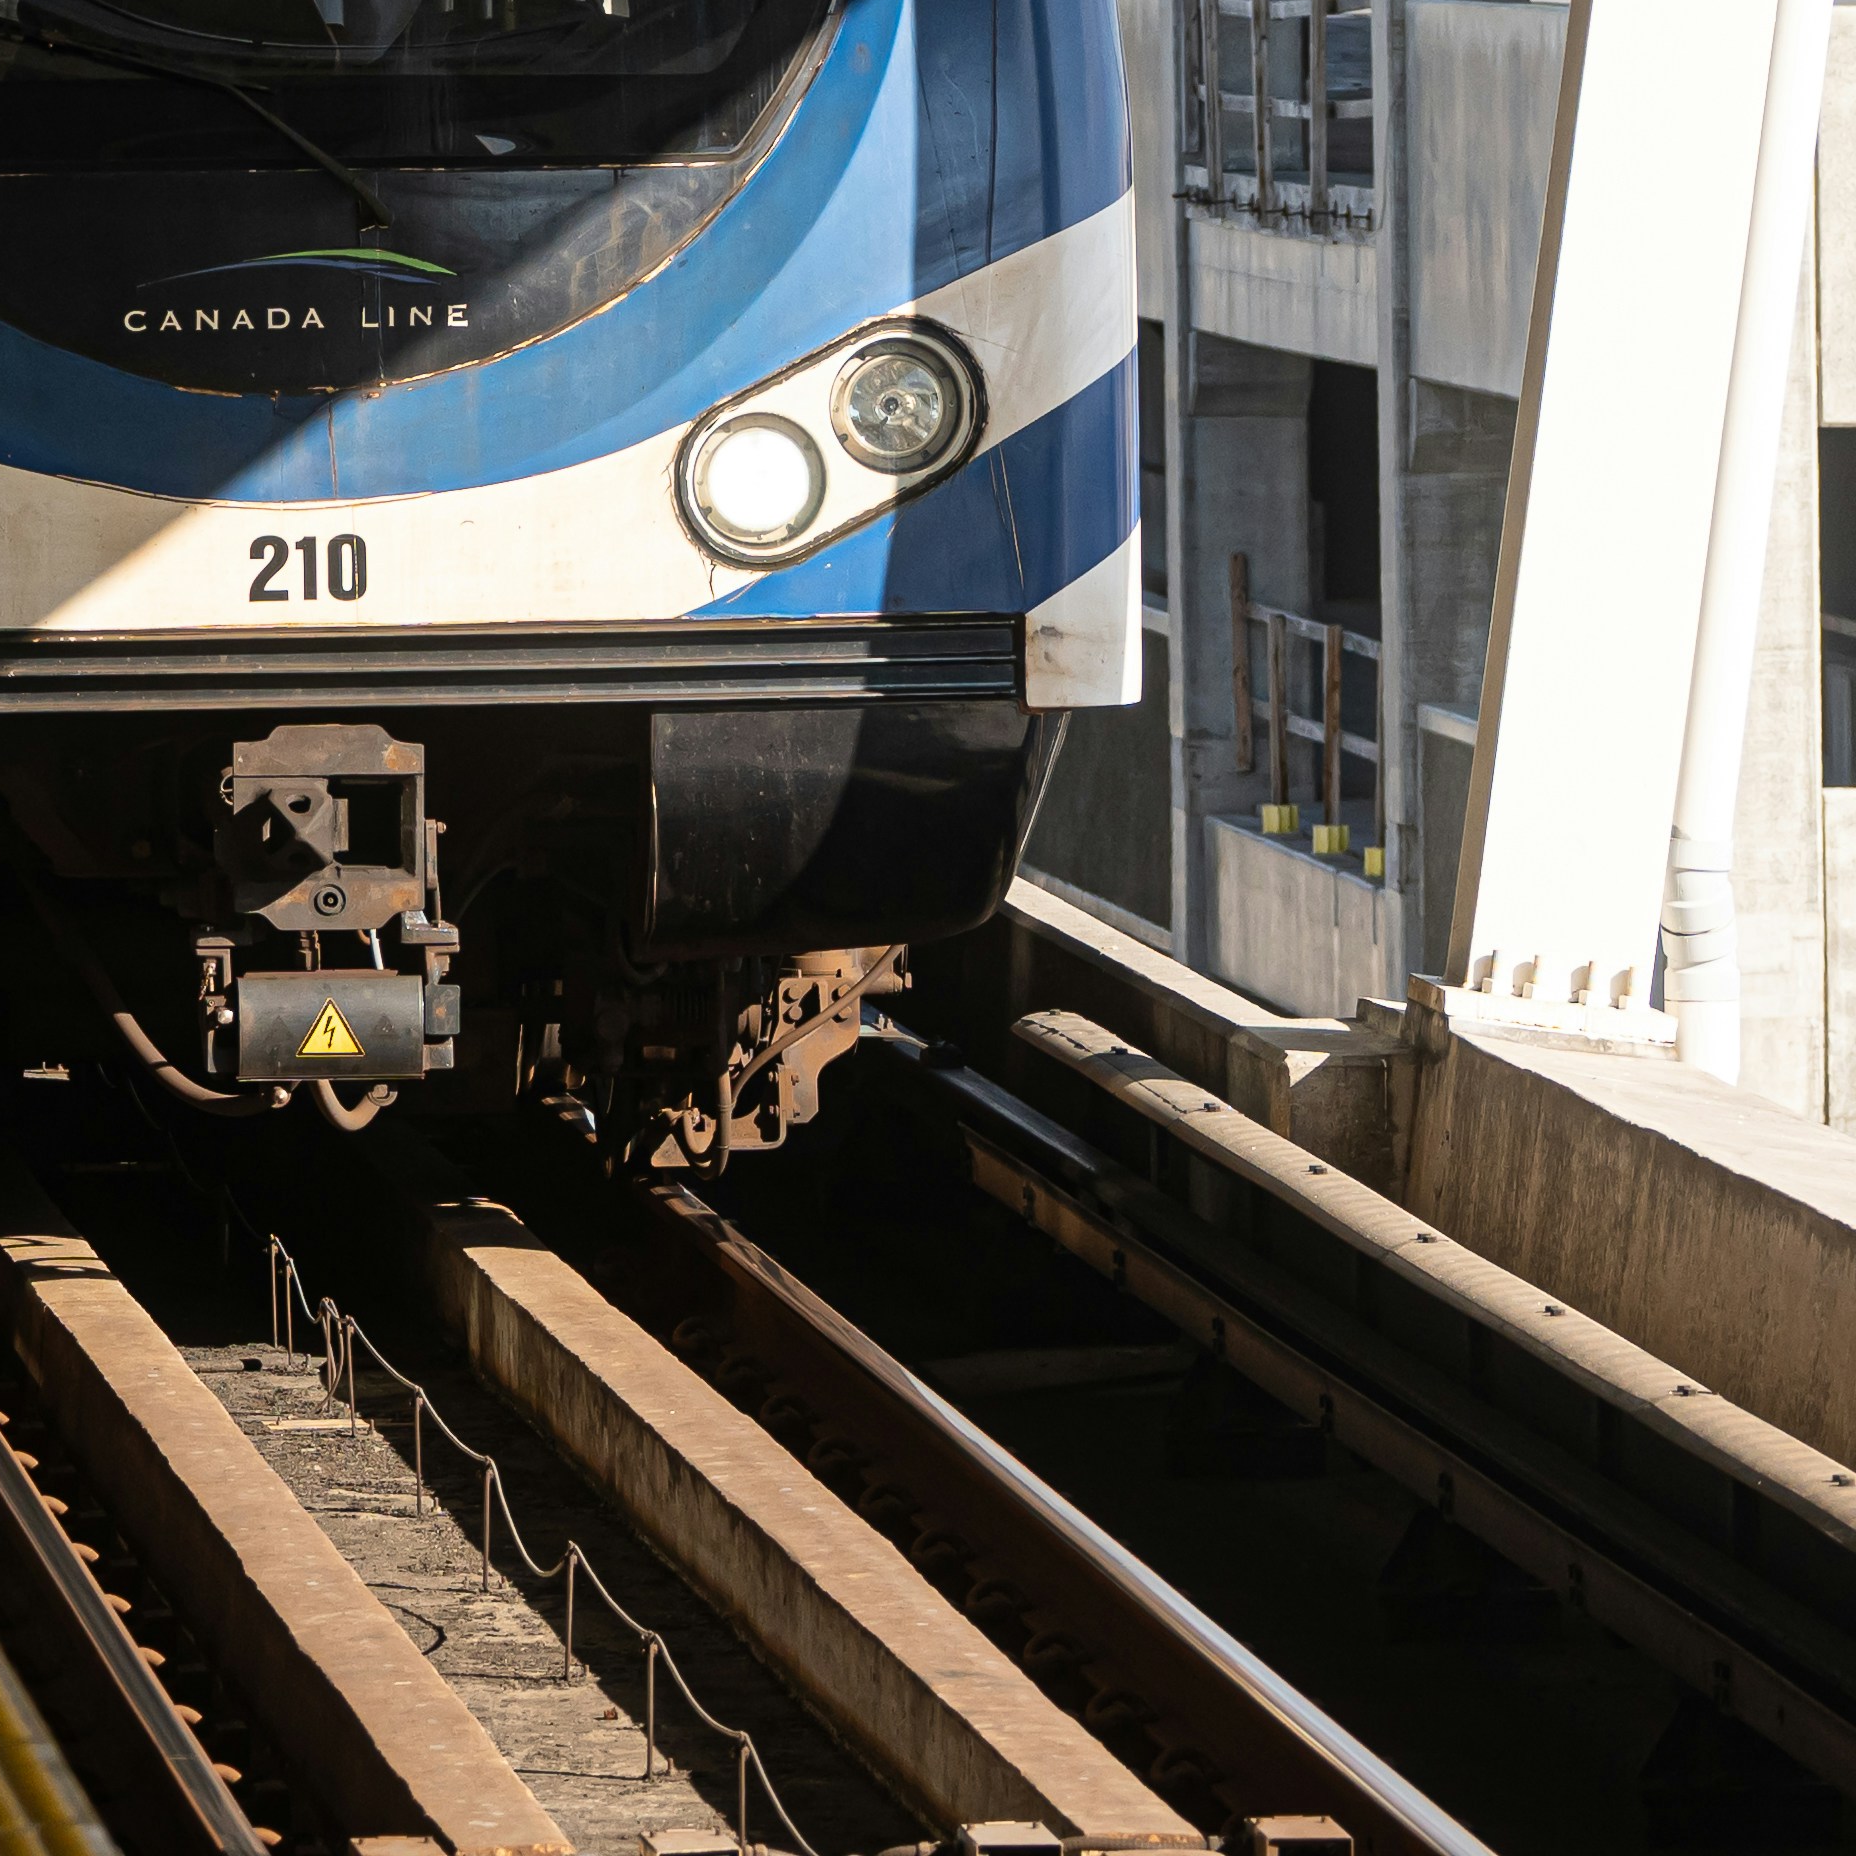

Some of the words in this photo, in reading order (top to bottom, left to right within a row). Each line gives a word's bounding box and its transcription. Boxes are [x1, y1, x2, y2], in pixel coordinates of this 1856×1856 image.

[124, 307, 325, 332] CANADA
[361, 303, 469, 328] LINE
[249, 533, 367, 603] 210
